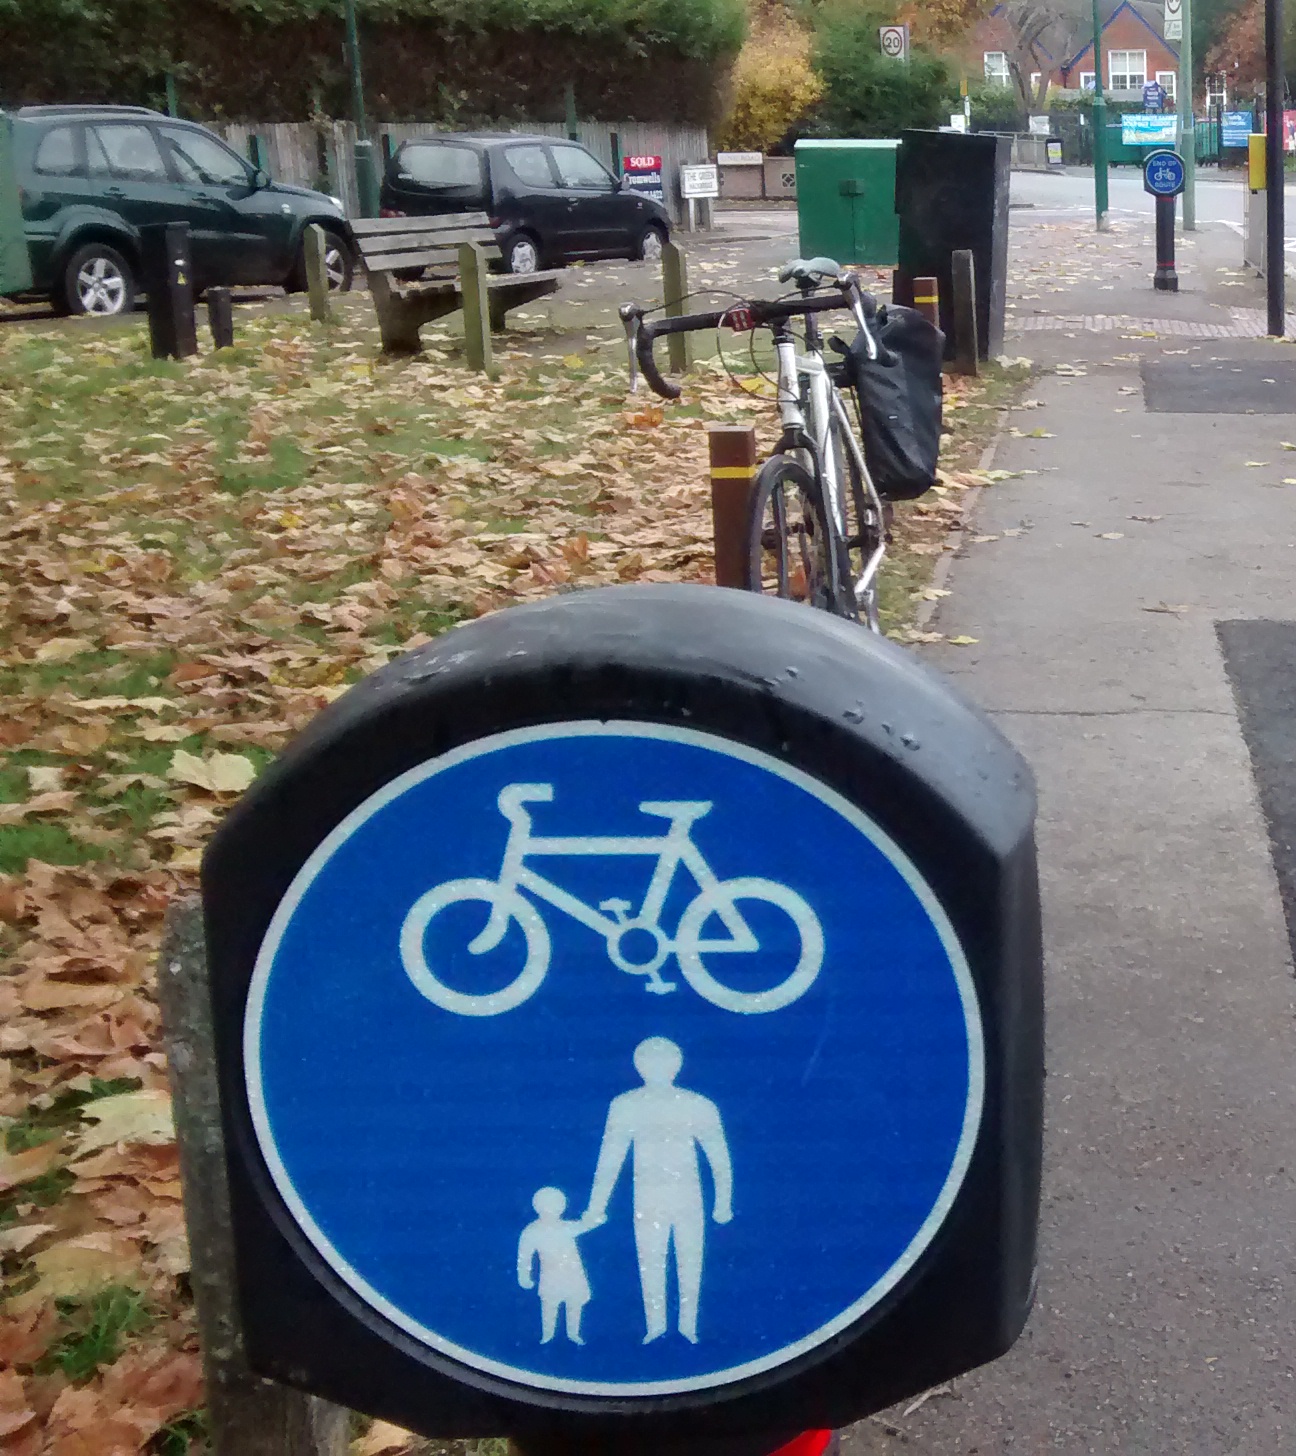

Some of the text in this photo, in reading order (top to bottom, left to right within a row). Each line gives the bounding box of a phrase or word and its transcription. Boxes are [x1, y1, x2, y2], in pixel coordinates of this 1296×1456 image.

[886, 37, 899, 48] 20
[630, 156, 655, 167] SOLD
[686, 172, 697, 181] THE
